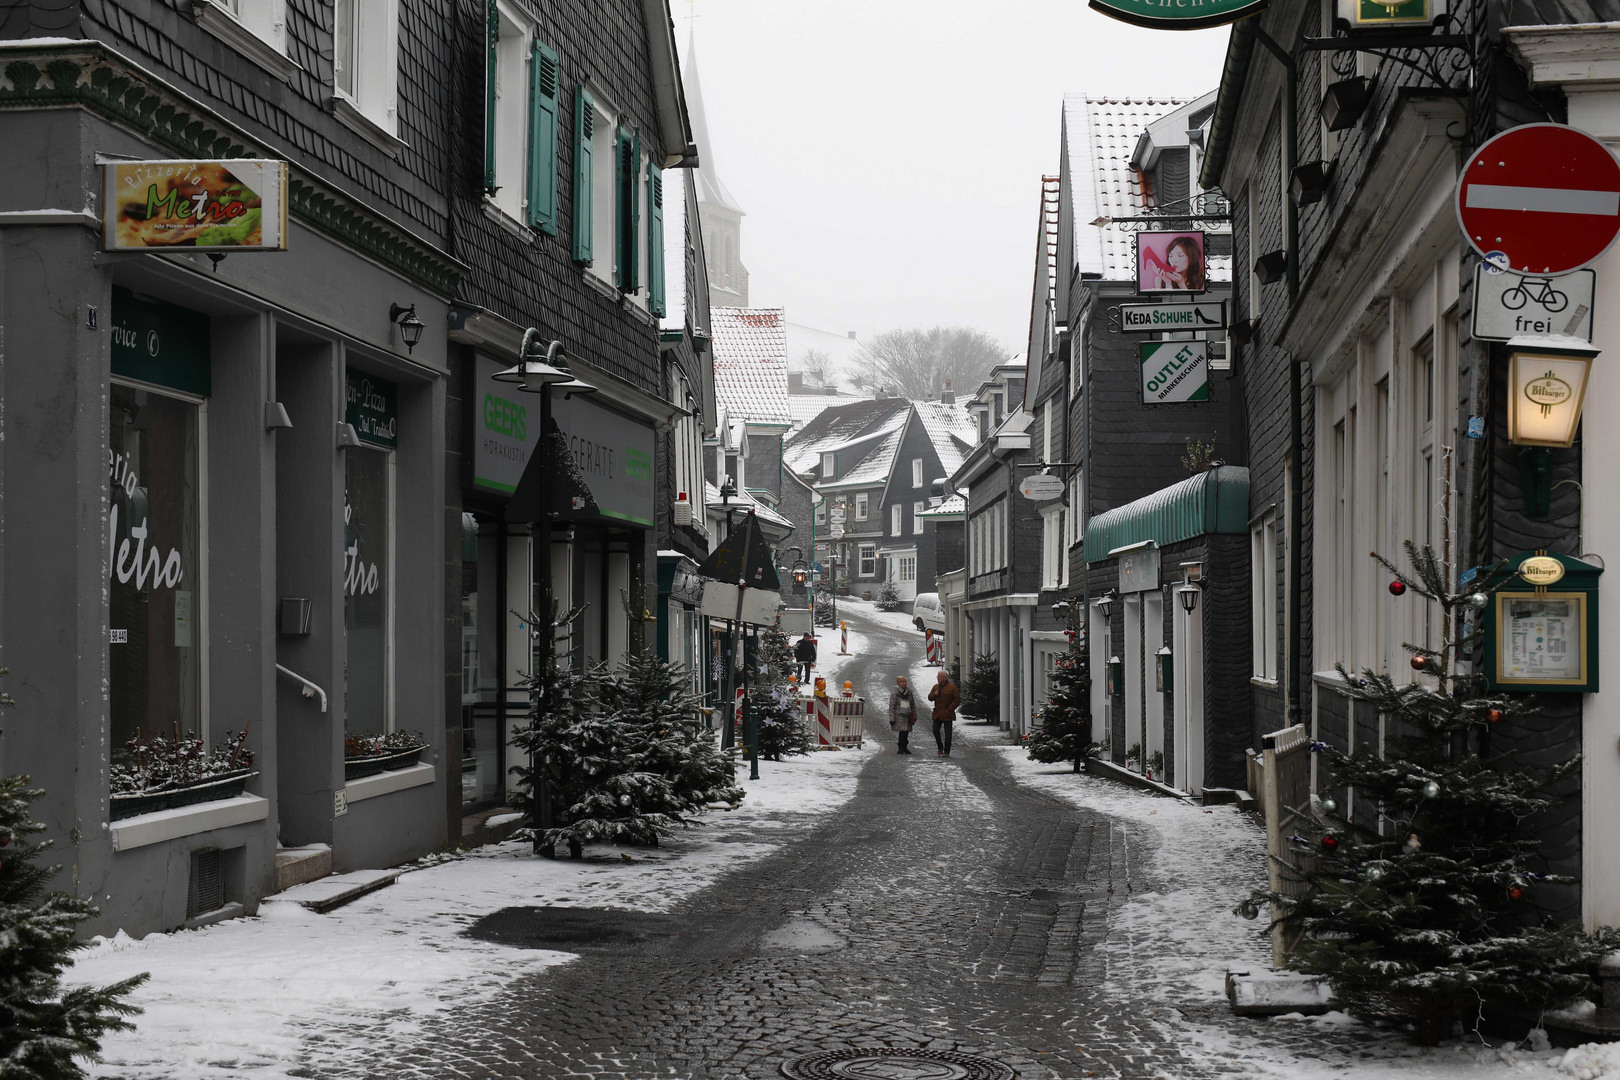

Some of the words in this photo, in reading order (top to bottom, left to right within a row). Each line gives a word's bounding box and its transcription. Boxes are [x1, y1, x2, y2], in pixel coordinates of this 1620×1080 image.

[124, 164, 202, 189] Pizzeria
[146, 183, 247, 220] Metro
[1125, 311, 1152, 325] KEDA
[1152, 309, 1193, 324] SCHUHE
[1515, 316, 1551, 333] frei
[1146, 345, 1194, 393] OUTLET
[1158, 354, 1205, 400] MARKENSCHUHE
[1531, 385, 1566, 398] Bitburger
[484, 393, 526, 441] GEERS
[562, 432, 613, 480] GERÄTE
[625, 446, 652, 482] GEERS
[344, 538, 379, 597] tro
[1526, 565, 1558, 576] Bitburger
